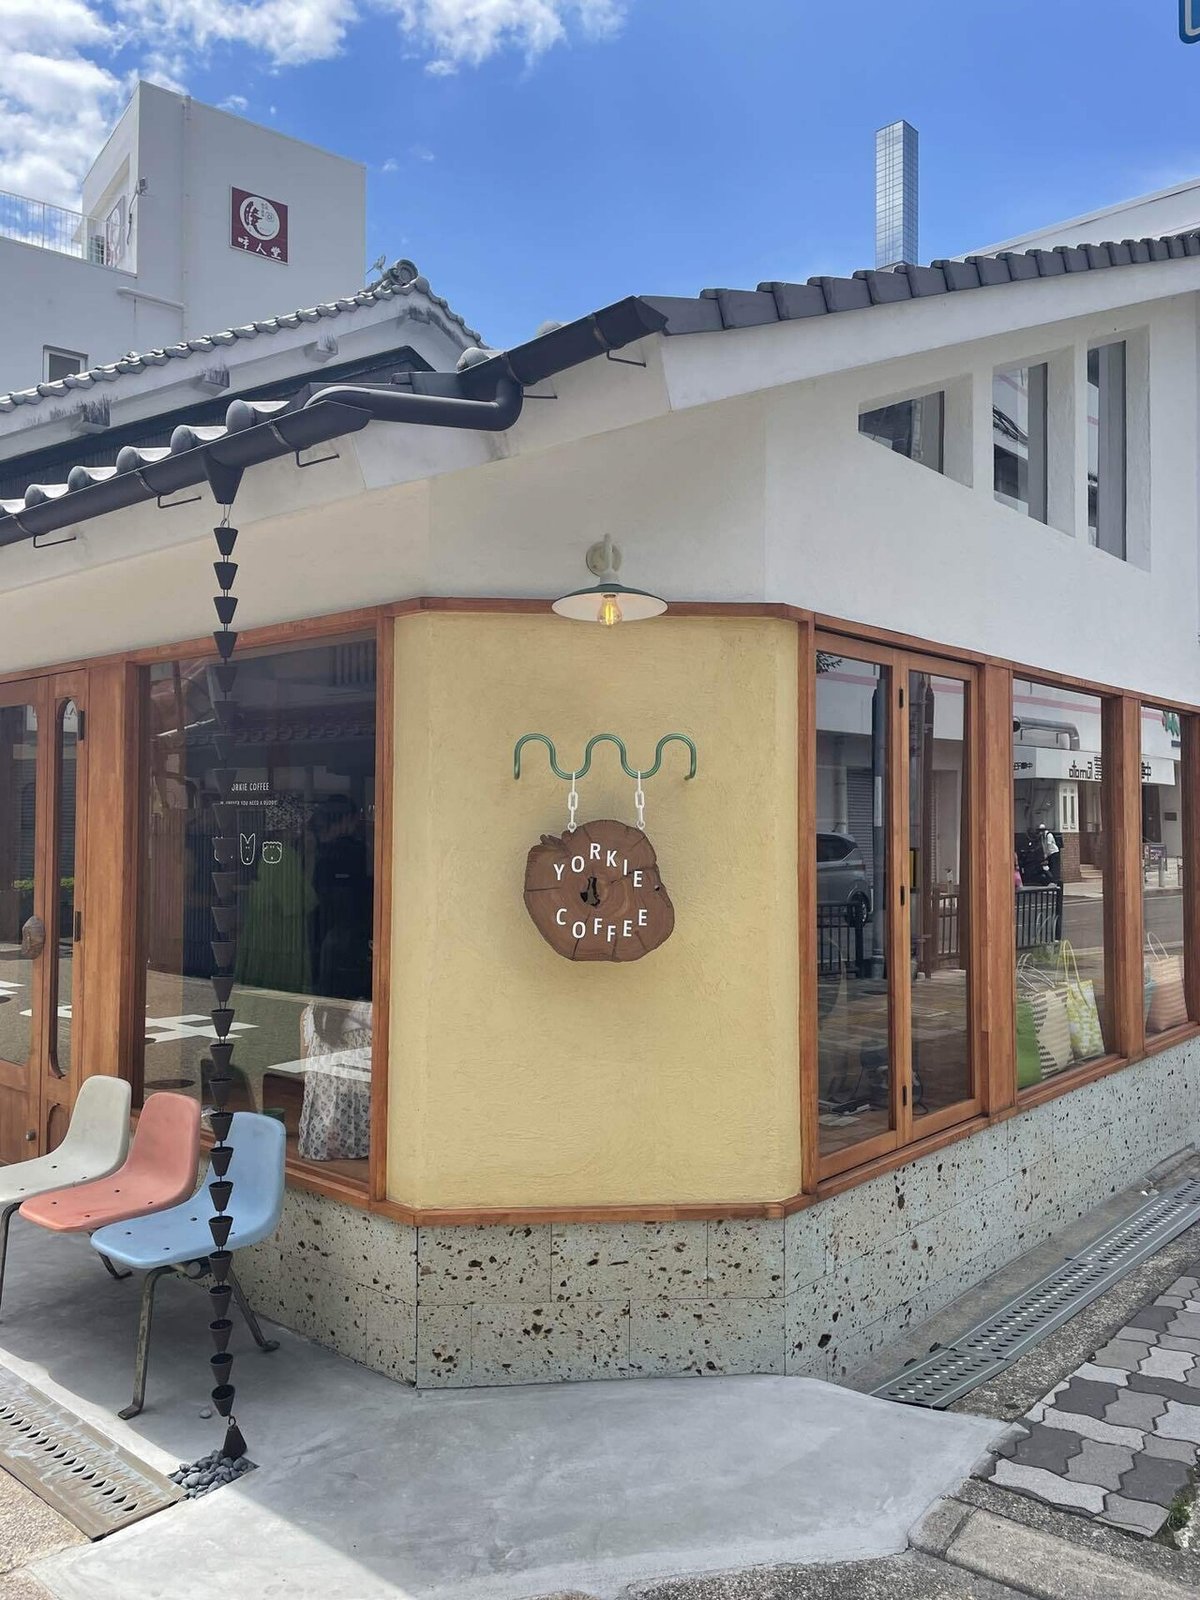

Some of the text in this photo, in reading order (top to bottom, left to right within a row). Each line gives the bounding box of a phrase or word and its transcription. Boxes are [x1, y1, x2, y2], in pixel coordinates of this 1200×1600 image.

[250, 782, 270, 791] COFFEE
[553, 842, 643, 888] YORKIE
[556, 908, 648, 943] COFFEE
